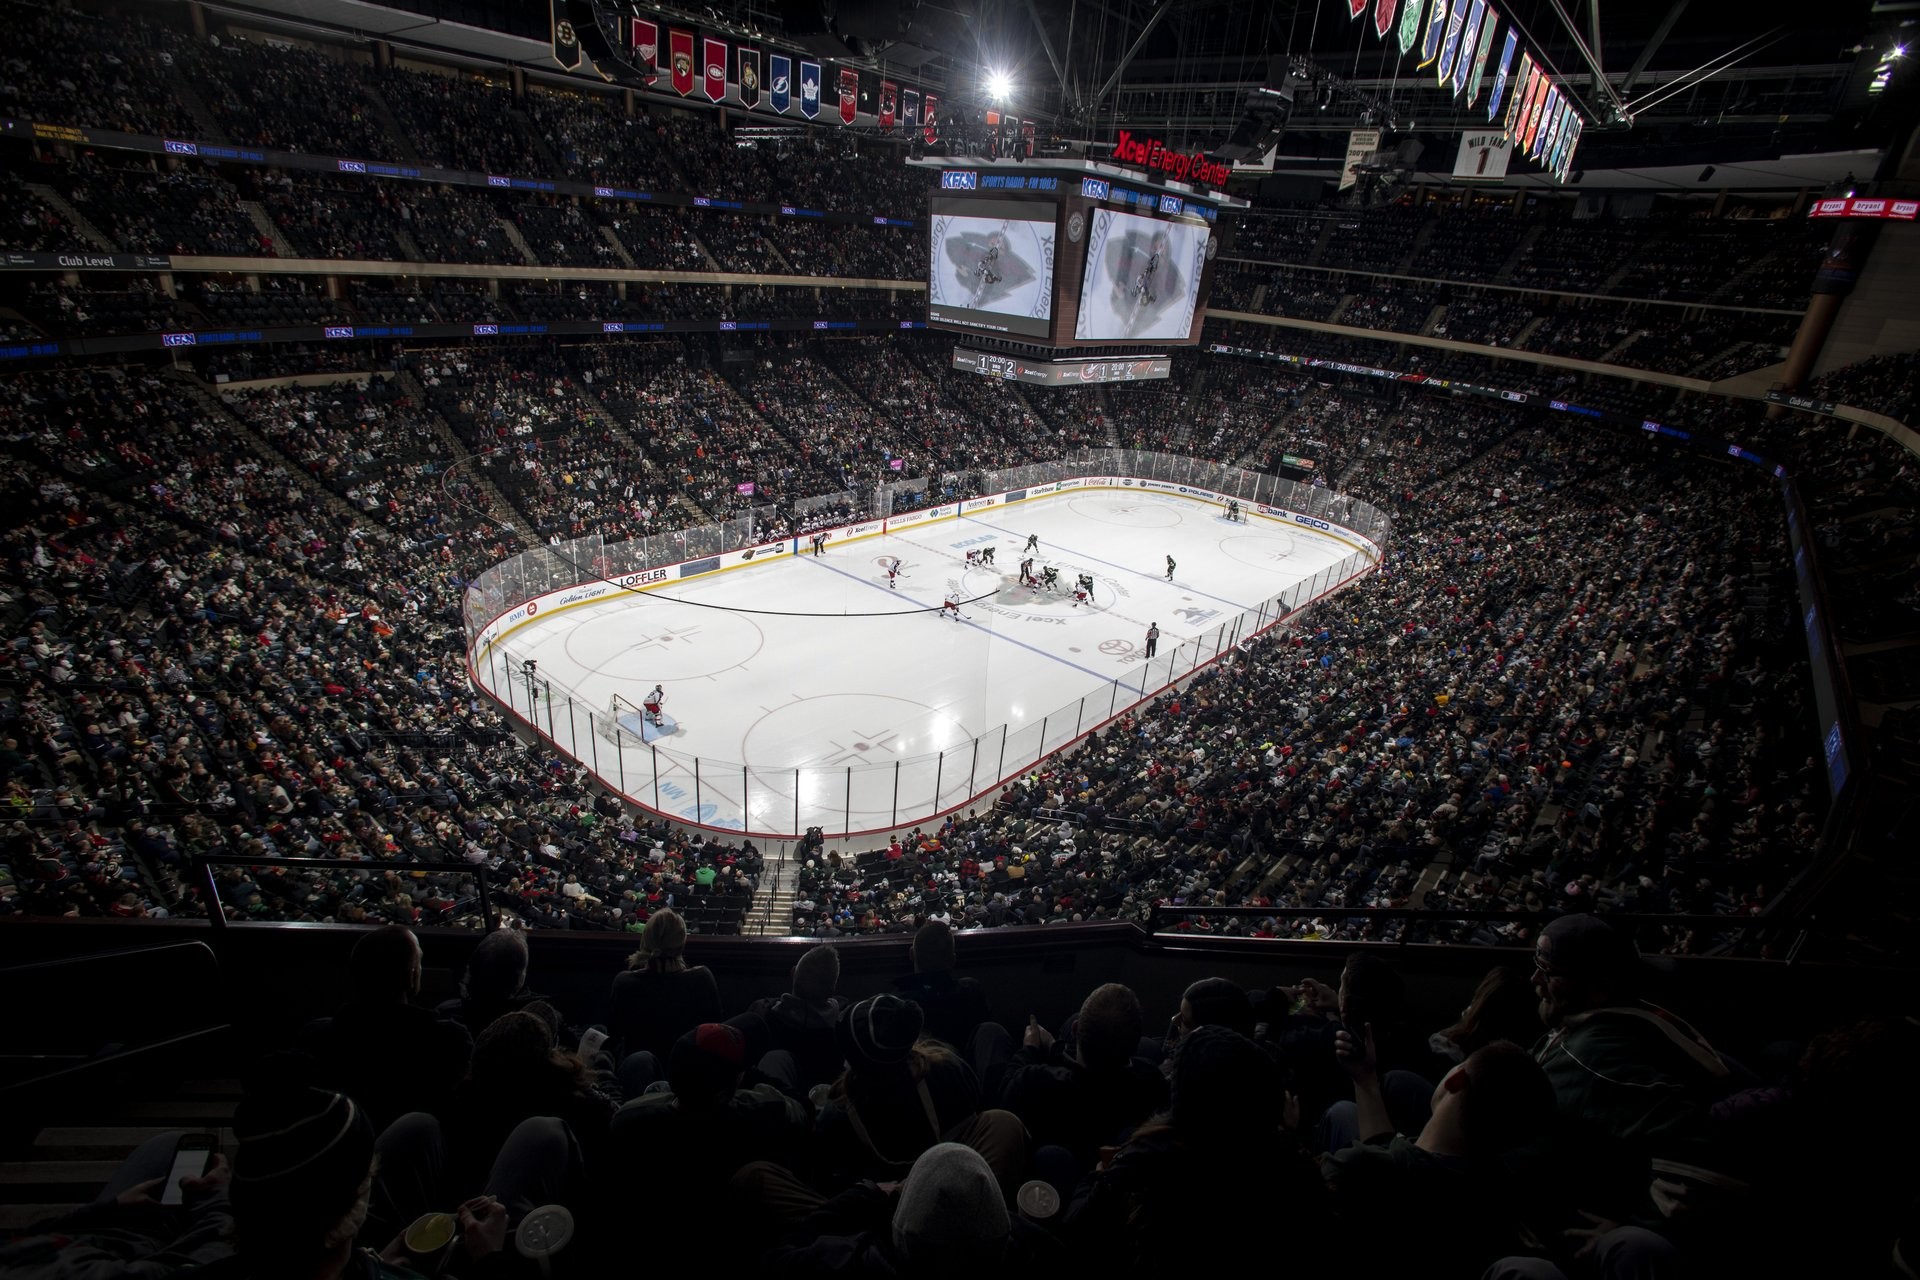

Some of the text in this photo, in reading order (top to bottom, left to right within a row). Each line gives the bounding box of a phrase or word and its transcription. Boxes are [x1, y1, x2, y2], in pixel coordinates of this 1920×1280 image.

[164, 140, 198, 156] KFAN
[1468, 136, 1486, 149] WILD
[1113, 129, 1231, 186] Xcel Energy Center
[1476, 147, 1491, 174] 1
[337, 160, 367, 174] KFAN
[942, 171, 978, 190] KFAN
[981, 176, 1004, 188] SPORTS
[1005, 177, 1025, 189] RADIO
[1028, 177, 1039, 189] FM
[1039, 178, 1058, 190] 100.3
[1081, 178, 1110, 201] KFAN
[1160, 195, 1183, 215] KFAN
[1823, 203, 1843, 211] bryant
[1856, 202, 1881, 211] bryant
[1895, 204, 1915, 213] bryant
[1041, 235, 1054, 271] Xcel
[58, 254, 115, 268] Club Level
[324, 326, 355, 339] KFAN
[473, 324, 499, 335] KFAN
[161, 332, 196, 347] KFAN
[980, 357, 986, 368] 1
[989, 355, 1005, 364] 20:00
[1007, 361, 1013, 373] 2
[1024, 368, 1049, 379] XcelEnergy
[1337, 363, 1357, 373] 20:00
[1188, 489, 1214, 499] POLARIS
[1295, 514, 1330, 531] GEICO
[620, 569, 667, 588] LOFFLER
[559, 595, 583, 606] Golden
[584, 588, 607, 599] LIGHT
[509, 609, 526, 623] BMO
[1025, 615, 1067, 626] Xcel
